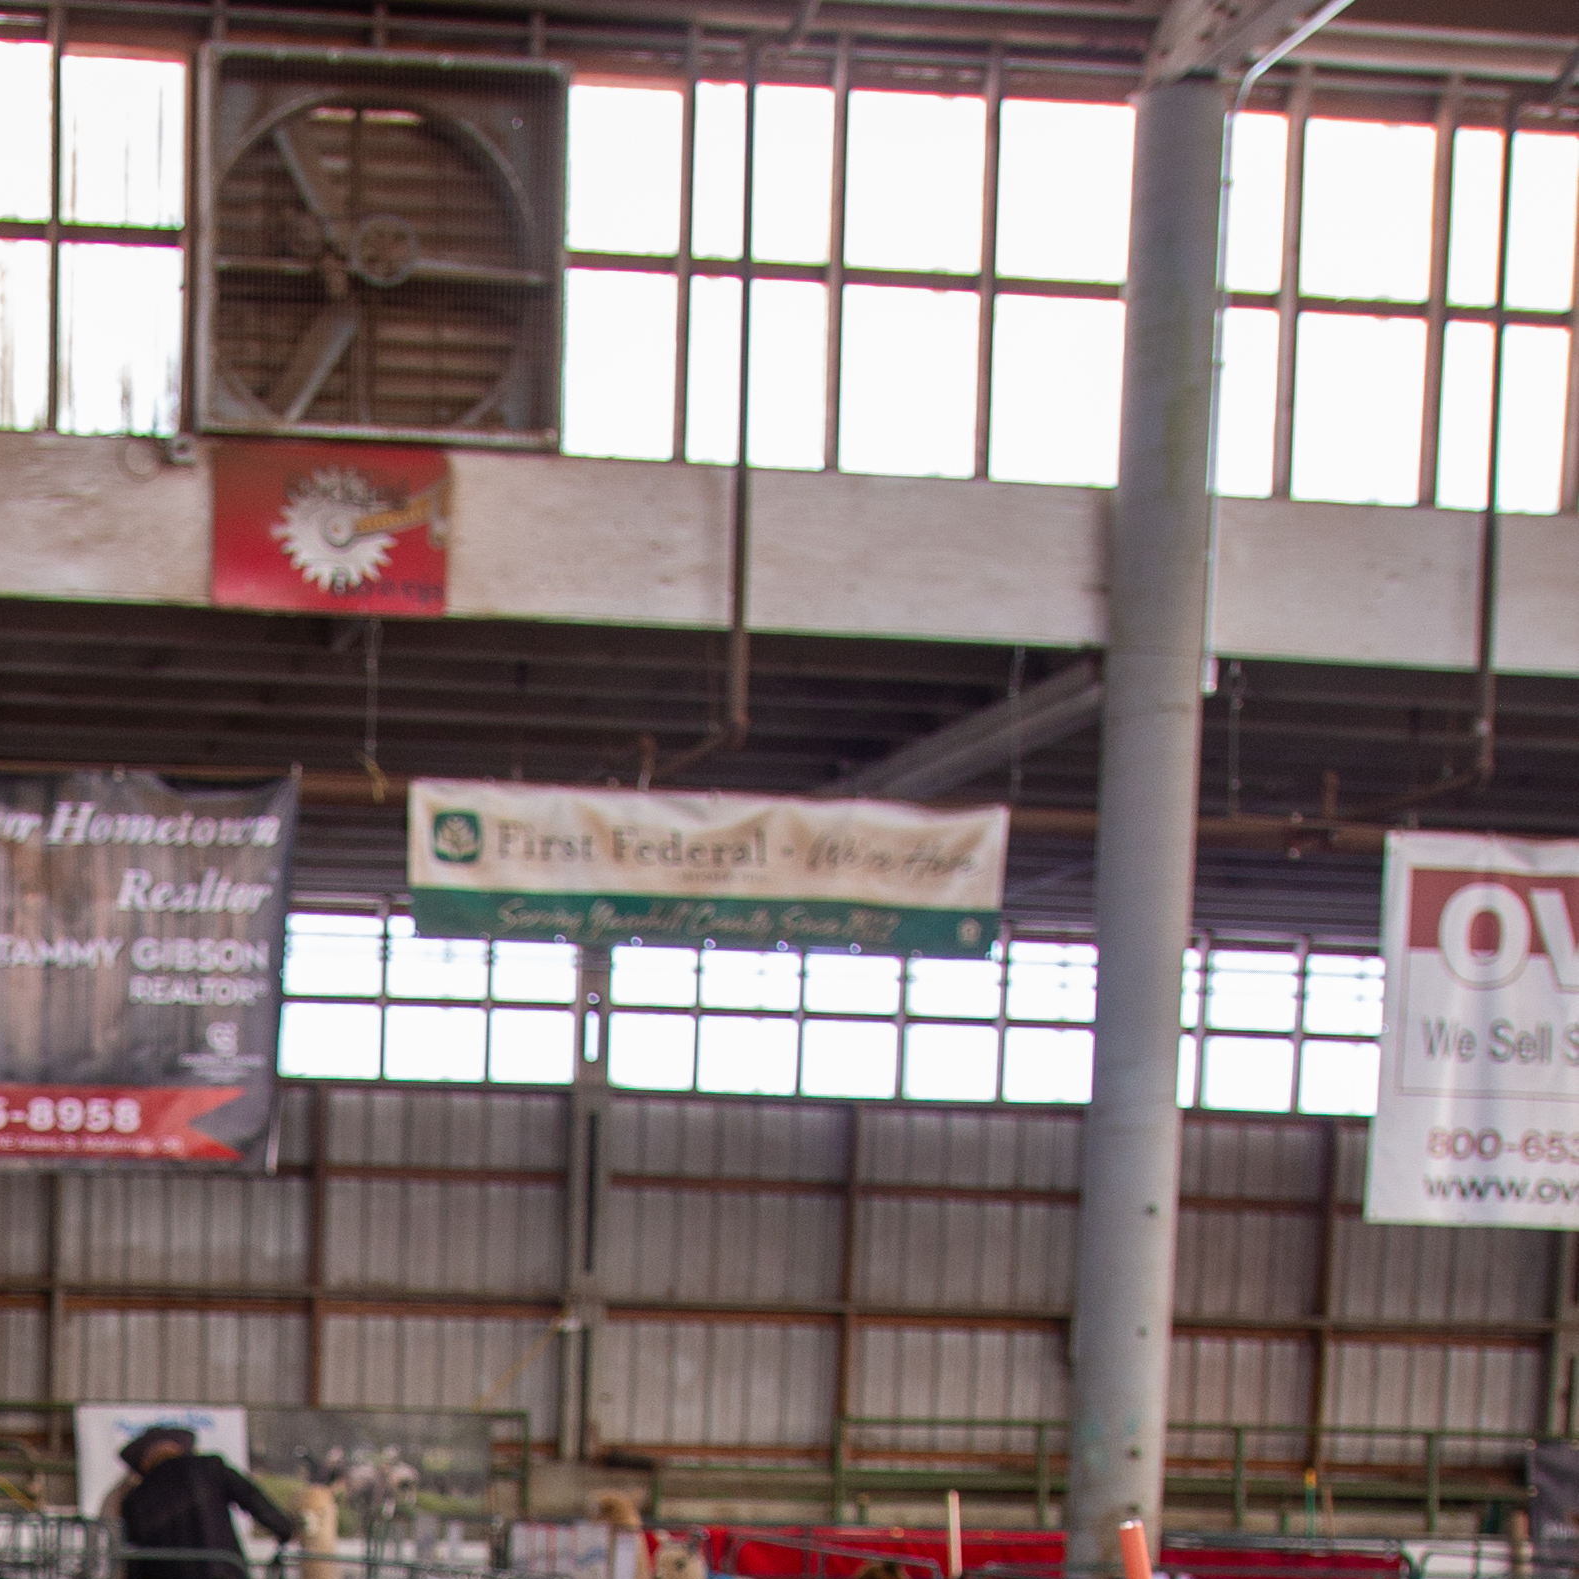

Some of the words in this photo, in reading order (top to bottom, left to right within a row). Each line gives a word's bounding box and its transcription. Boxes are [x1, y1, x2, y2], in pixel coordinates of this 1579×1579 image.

[44, 799, 282, 848] Hometown
[498, 818, 594, 863] First
[610, 815, 769, 868] Federal
[117, 866, 273, 915] Realtor
[130, 936, 270, 972] GIBSON
[1422, 1016, 1477, 1063] We
[1486, 1017, 1553, 1066] Sell
